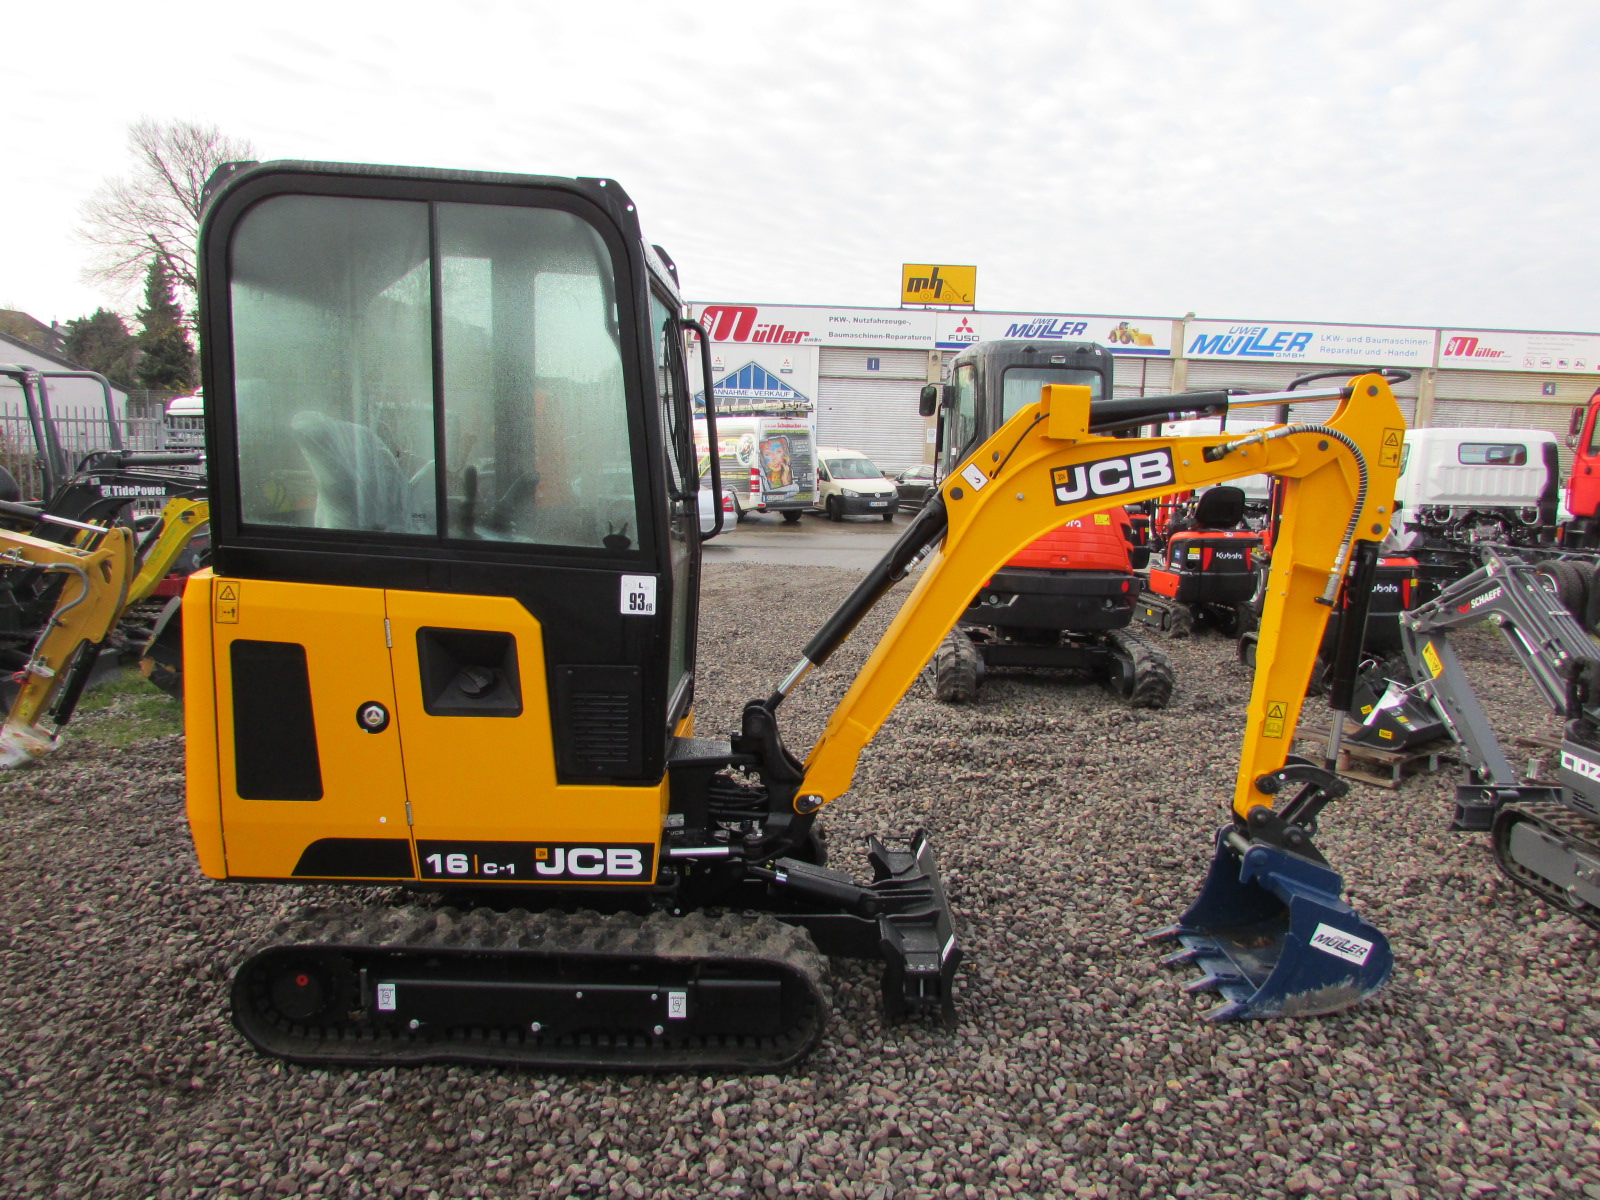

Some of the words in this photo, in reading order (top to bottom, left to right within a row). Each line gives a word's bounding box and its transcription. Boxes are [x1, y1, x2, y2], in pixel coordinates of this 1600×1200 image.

[694, 305, 810, 344] Müller
[1004, 318, 1088, 339] MÜLLER
[1228, 326, 1261, 335] UWE
[828, 331, 932, 342] Baumaschinen-Reparaturen
[948, 334, 980, 342] FUSO
[1187, 327, 1314, 357] MÜLLER
[1320, 334, 1344, 342] LKW-
[1365, 336, 1432, 347] Baumaschinen-
[1319, 345, 1362, 355] Reparatur
[1364, 348, 1381, 356] und
[1384, 349, 1418, 357] -Handel
[1443, 336, 1505, 358] Müller
[1545, 384, 1553, 394] 4
[1056, 451, 1172, 502] JCB
[112, 485, 166, 496] TidePower
[1470, 586, 1502, 609] SCHAEFF
[426, 853, 469, 874] 16
[535, 848, 643, 876] JCB
